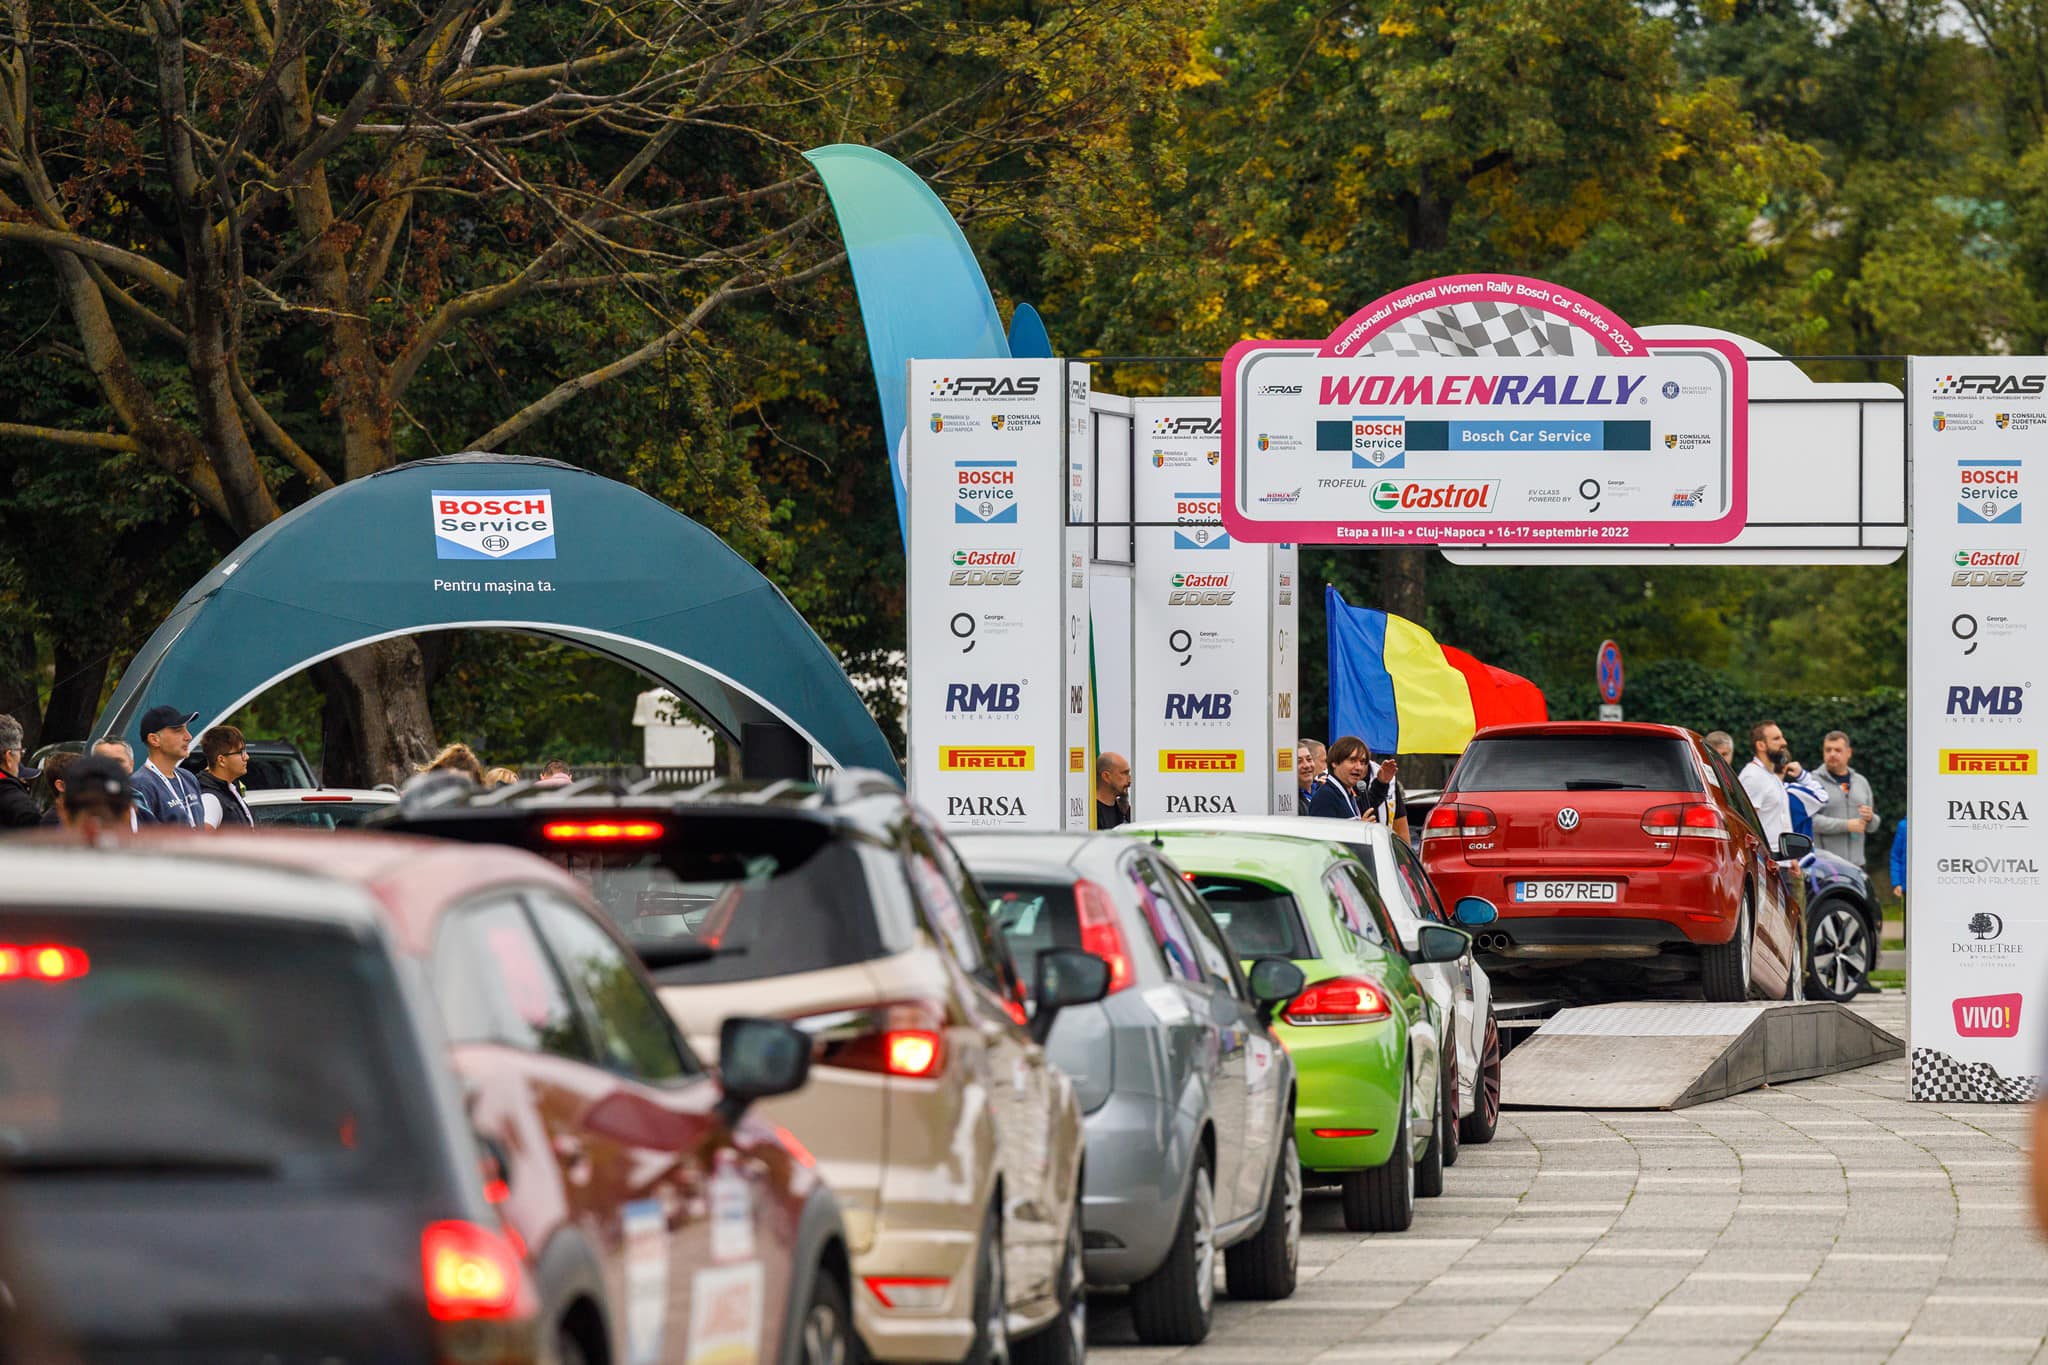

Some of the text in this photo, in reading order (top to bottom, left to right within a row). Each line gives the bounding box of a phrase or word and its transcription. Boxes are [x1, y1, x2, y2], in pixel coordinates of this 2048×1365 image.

[1334, 305, 1393, 356] Campionatul
[1438, 283, 1484, 296] Women
[1486, 281, 1514, 295] Rally
[1516, 284, 1550, 302] Bosch
[1552, 294, 1573, 309] Car
[1572, 303, 1610, 333] Service
[1608, 329, 1634, 356] 2022
[952, 376, 1041, 396] FRAS
[1267, 385, 1303, 394] FRAS
[1956, 375, 2047, 394] FRAS
[1172, 417, 1222, 434] FRA
[1355, 424, 1402, 436] BOSCH
[1354, 437, 1403, 449] Service
[1462, 429, 1592, 442] Bosch Car Service
[958, 471, 1014, 485] BOSCH
[1317, 479, 1368, 488] TROFEUL
[1961, 470, 2018, 484] BOSCH
[958, 487, 1014, 499] Service
[1401, 483, 1490, 509] Castrol
[1961, 487, 2018, 499] Service
[439, 500, 545, 515] BOSCH
[1177, 502, 1221, 514] BOSC
[441, 518, 547, 532] Service
[1337, 526, 1630, 539] Etapa a III-a Cluj-Napoca 16-17 septembrie 2022
[968, 551, 1017, 566] Castrol
[1970, 551, 2020, 566] Castrol
[949, 570, 1024, 586] EDGE
[1185, 574, 1229, 587] Castrol
[1951, 570, 2028, 587] EDGE
[434, 579, 556, 595] Pentru mașina ta.
[1168, 591, 1236, 606] EDGE
[945, 683, 1020, 712] RMB
[1946, 686, 2023, 715] RMB
[1165, 693, 1233, 719] RMB
[948, 750, 1027, 768] PIRELLI
[1167, 753, 1237, 770] PIRELLI
[1949, 753, 2030, 771] PIRELLI
[947, 796, 1027, 816] PARSA
[1166, 796, 1238, 813] PARSA
[1946, 800, 2029, 821] PARSA
[971, 818, 1002, 826] BEAUTY
[1972, 823, 2004, 831] BEAUTY
[1468, 842, 1496, 850] GOLF
[1937, 856, 2039, 874] GEROVITAL
[1937, 876, 1975, 886] DOCTOR
[1525, 883, 1538, 899] B
[1962, 1006, 2010, 1029] VIVO!
